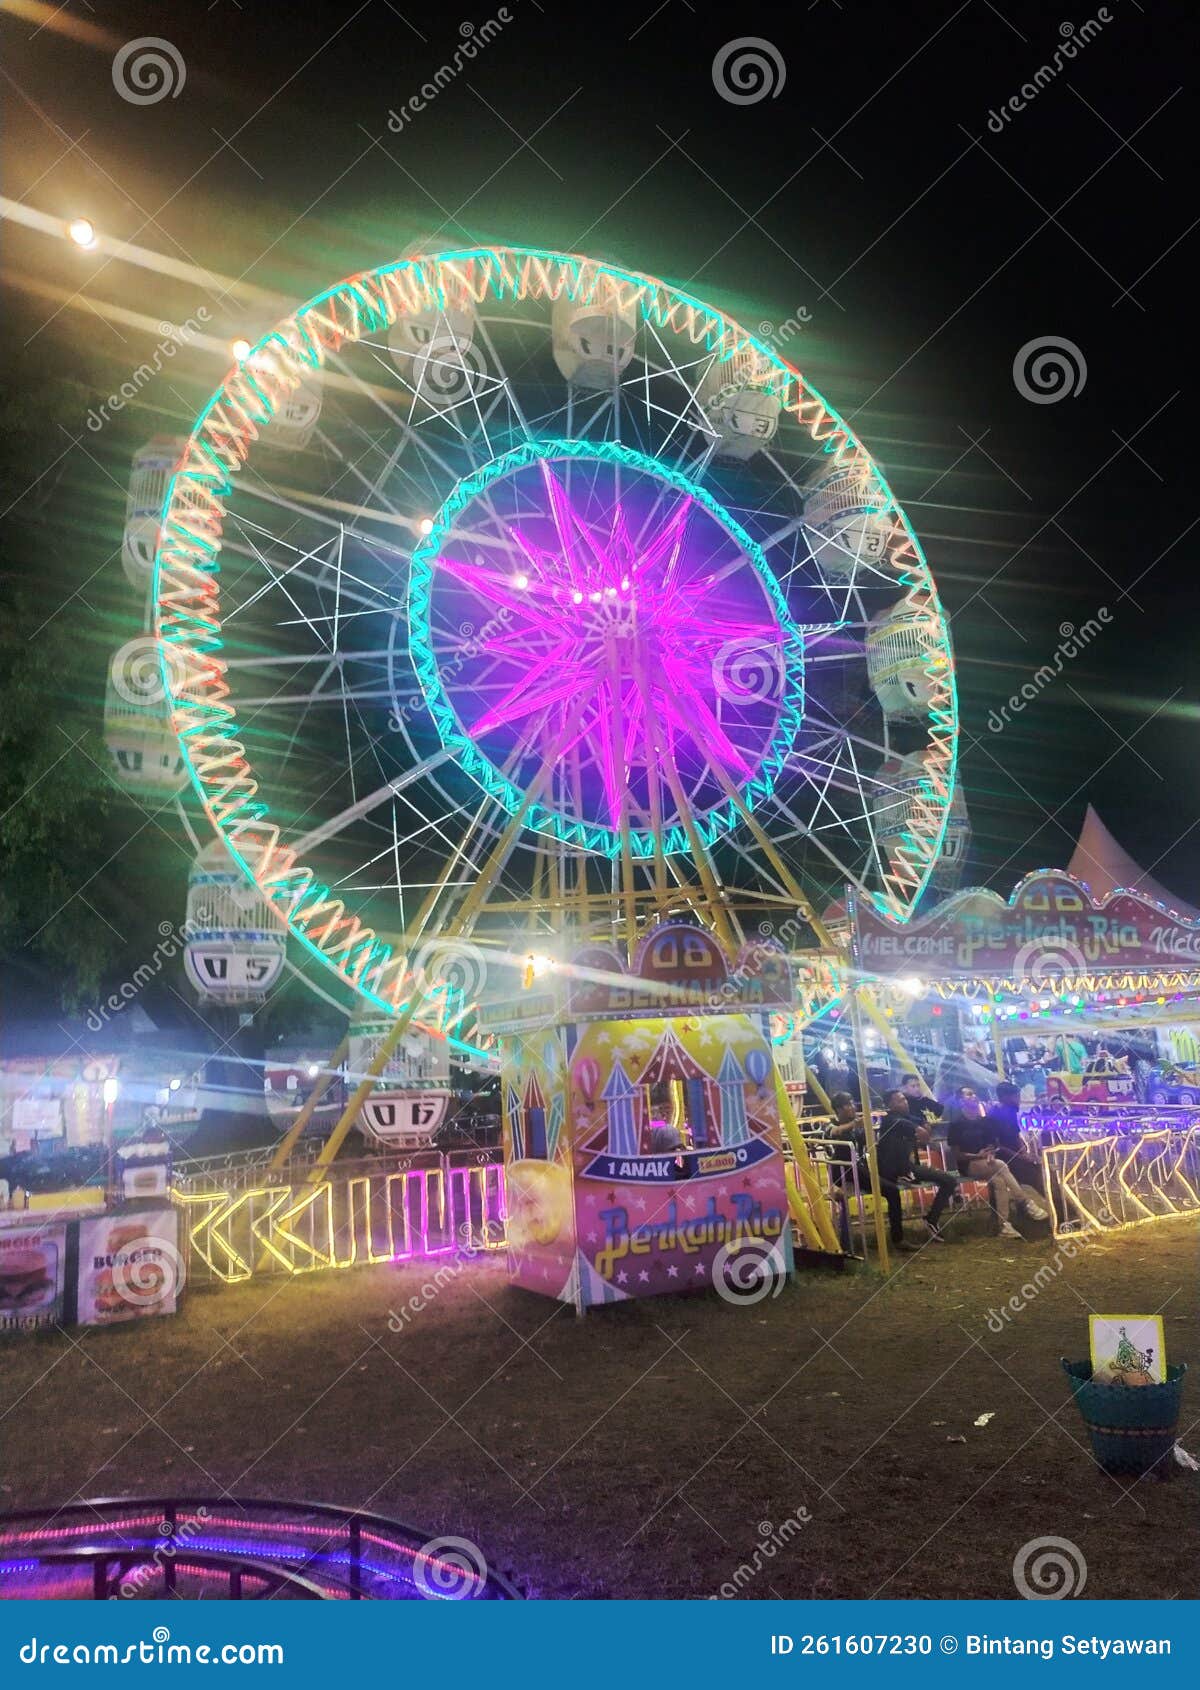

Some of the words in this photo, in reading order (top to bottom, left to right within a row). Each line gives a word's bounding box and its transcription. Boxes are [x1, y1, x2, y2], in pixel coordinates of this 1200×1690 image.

[862, 932, 954, 956] WELCOME
[203, 957, 273, 981] 05
[373, 1103, 435, 1126] 06
[619, 1160, 671, 1177] ANAK
[595, 1196, 730, 1281] Berkah
